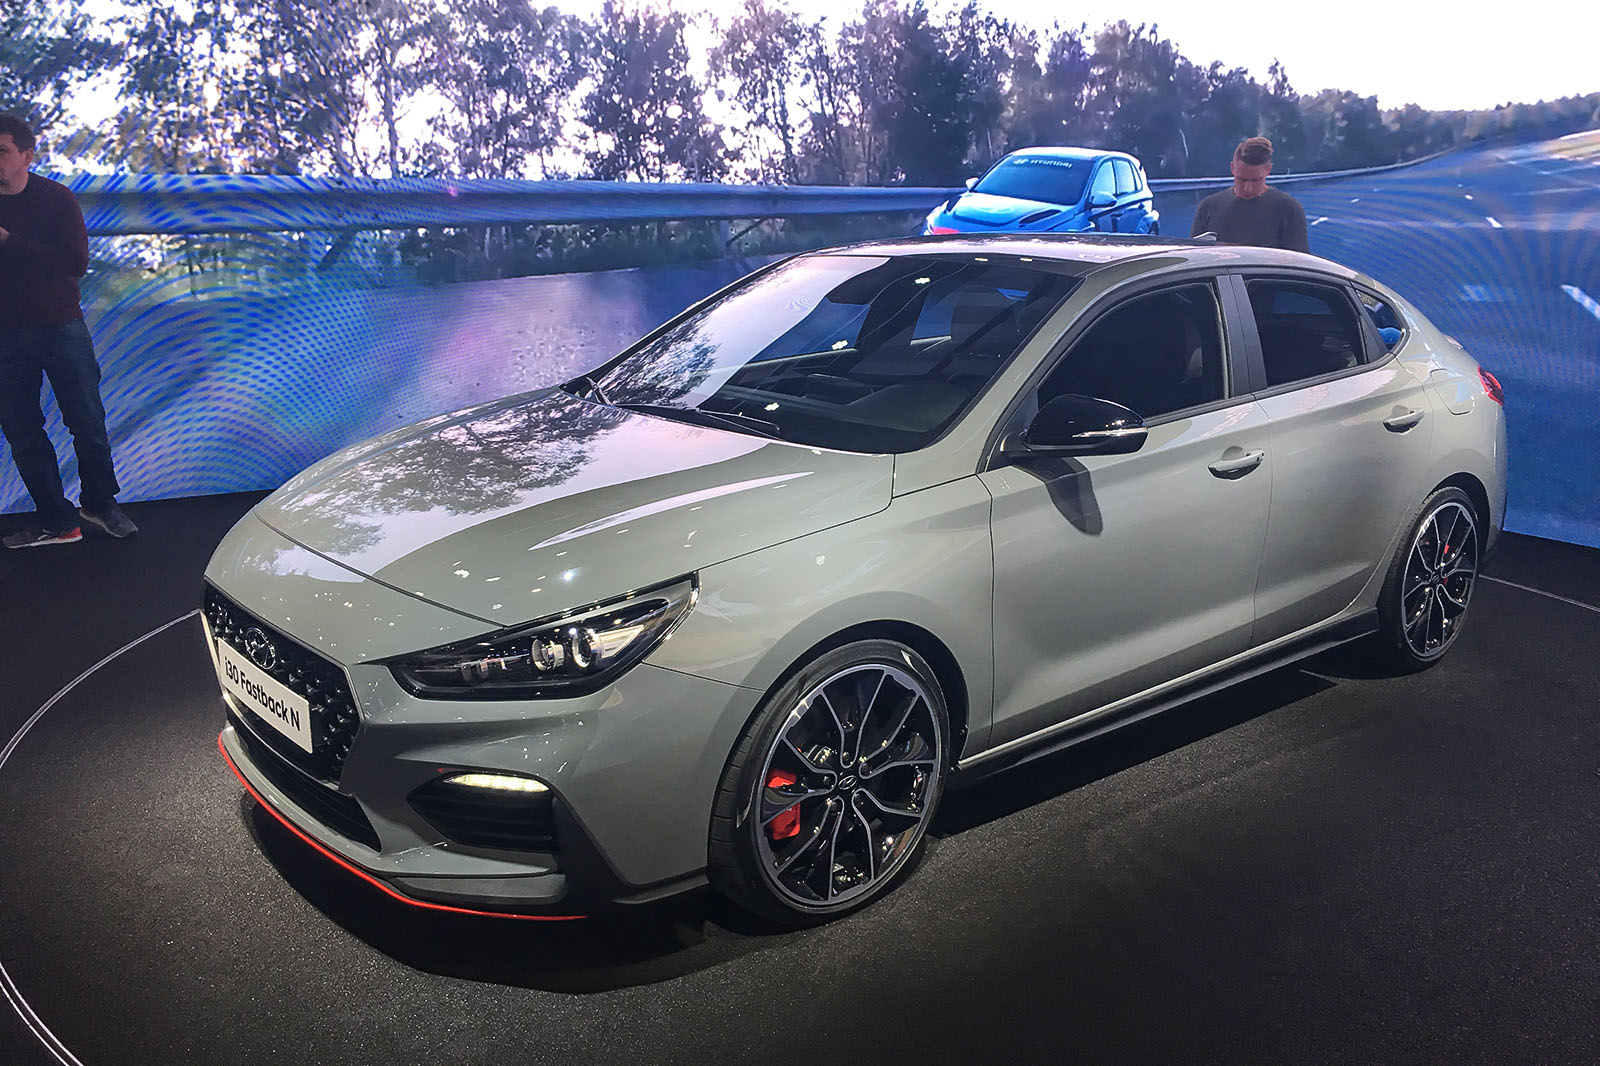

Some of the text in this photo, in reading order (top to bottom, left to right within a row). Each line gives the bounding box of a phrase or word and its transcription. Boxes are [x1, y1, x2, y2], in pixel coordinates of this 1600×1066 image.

[224, 656, 301, 731] i30 Fastback N
